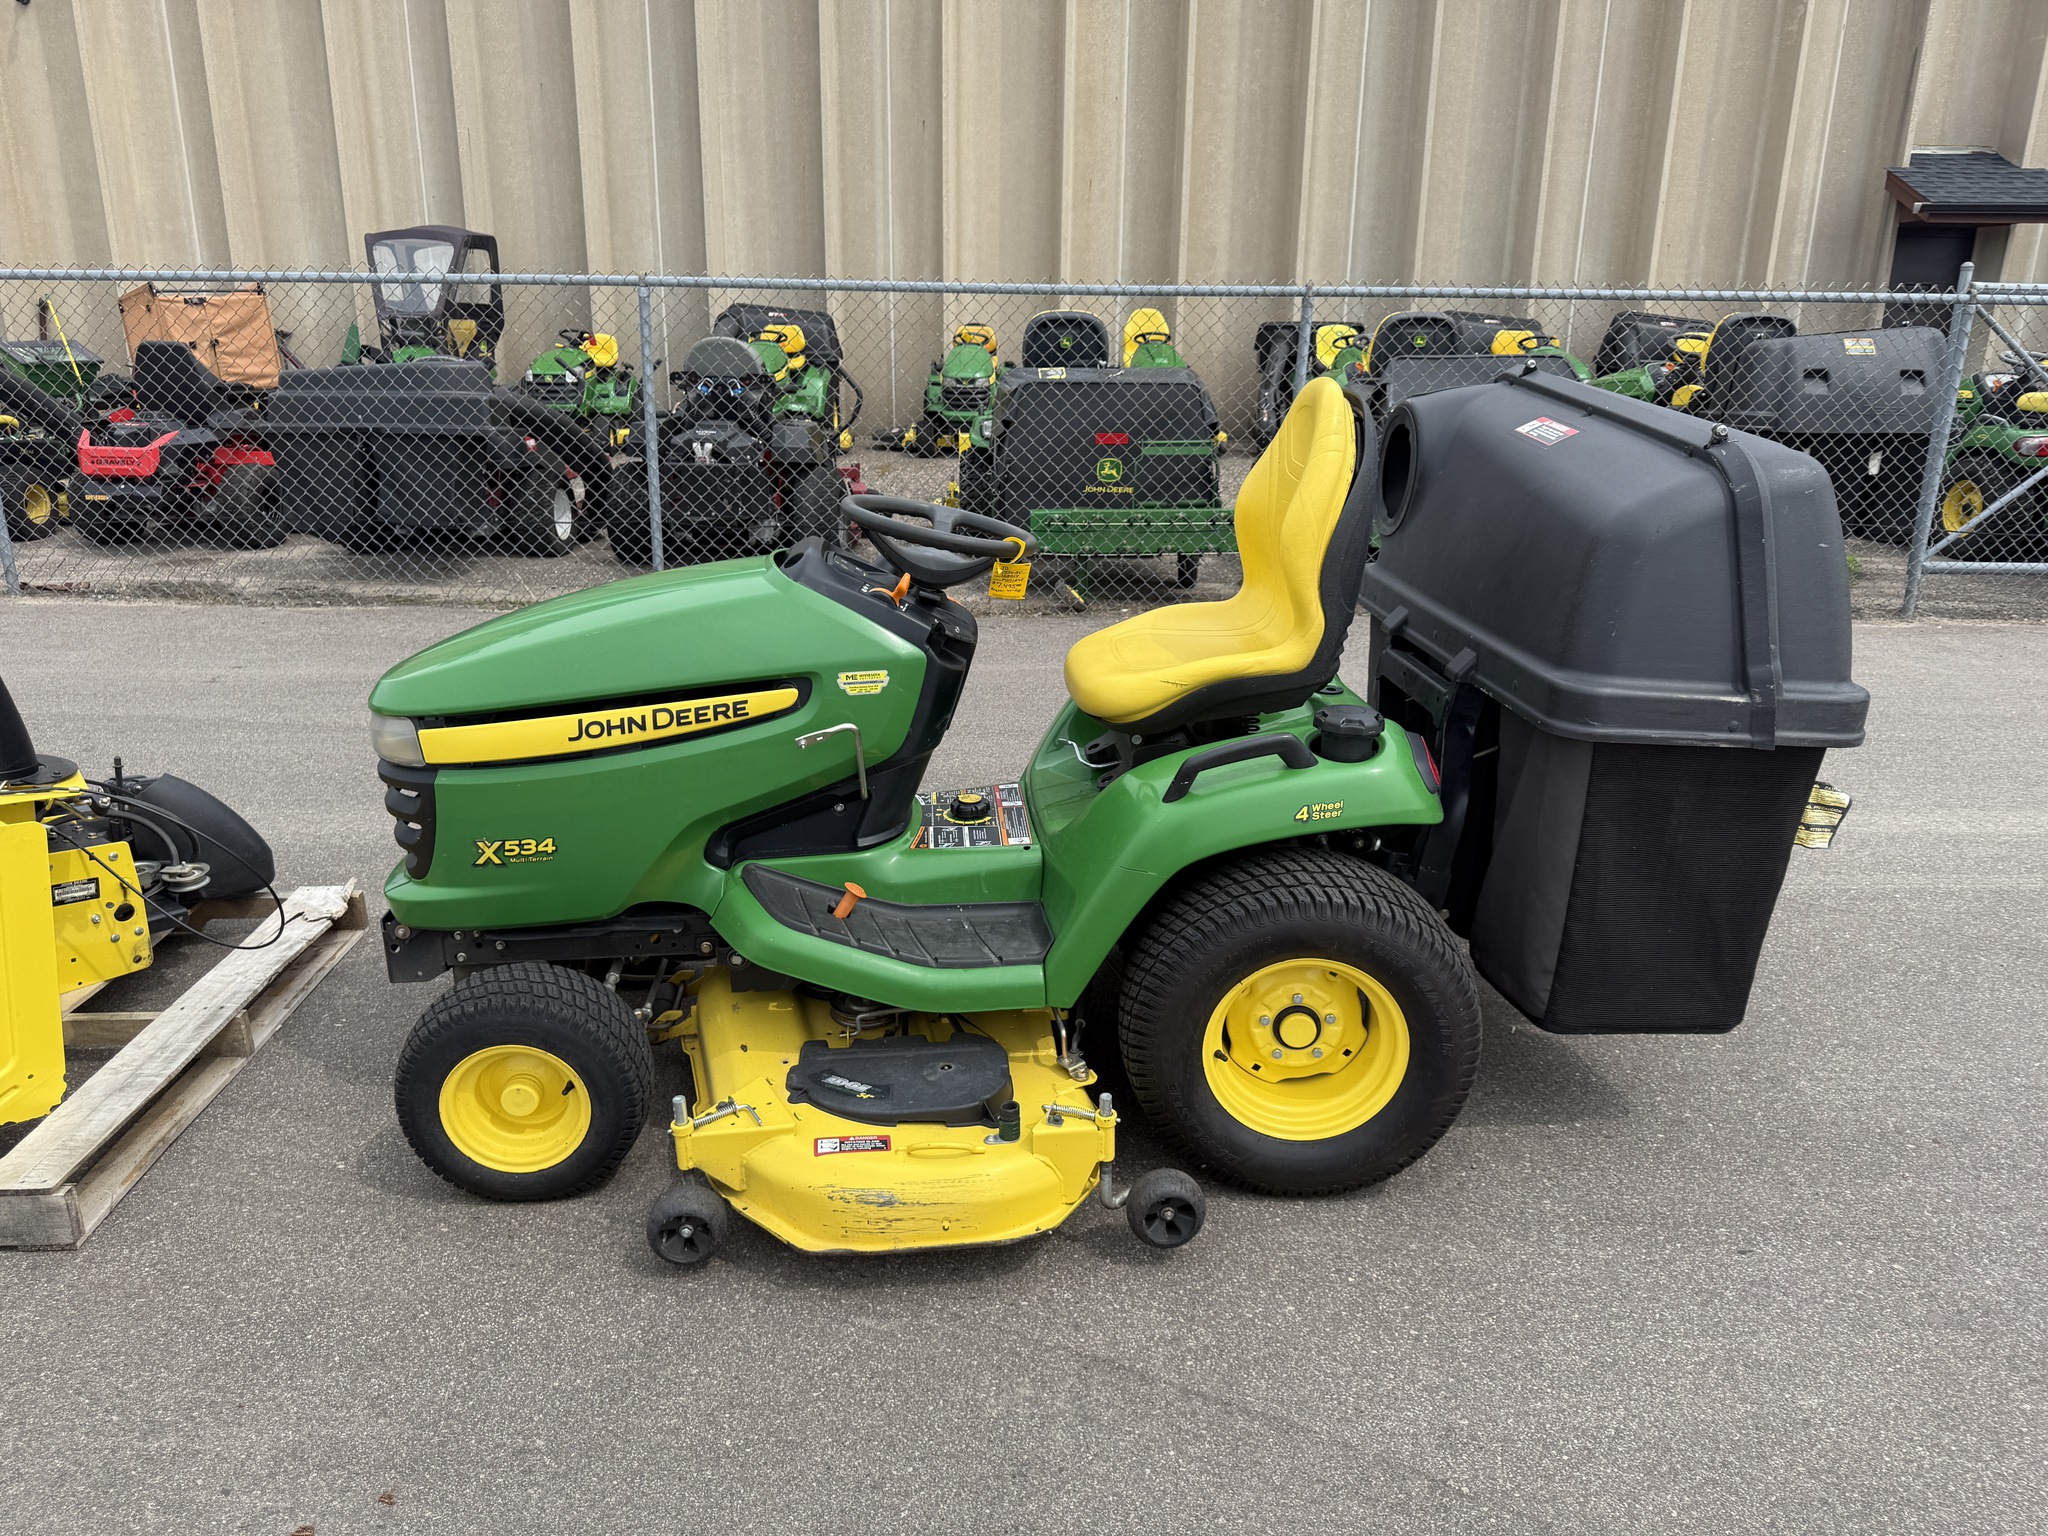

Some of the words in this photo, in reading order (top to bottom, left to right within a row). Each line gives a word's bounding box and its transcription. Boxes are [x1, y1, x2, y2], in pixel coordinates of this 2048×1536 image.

[1083, 485, 1106, 493] JOHN
[1107, 485, 1134, 494] DEERE
[568, 715, 647, 741] JOHN
[652, 700, 749, 730] DEERE
[1295, 805, 1309, 821] 4
[1311, 800, 1344, 812] Wheel
[1311, 810, 1343, 820] Steer
[474, 837, 557, 866] X534
[1364, 936, 1416, 968] TURF
[1412, 973, 1456, 1058] MASTER
